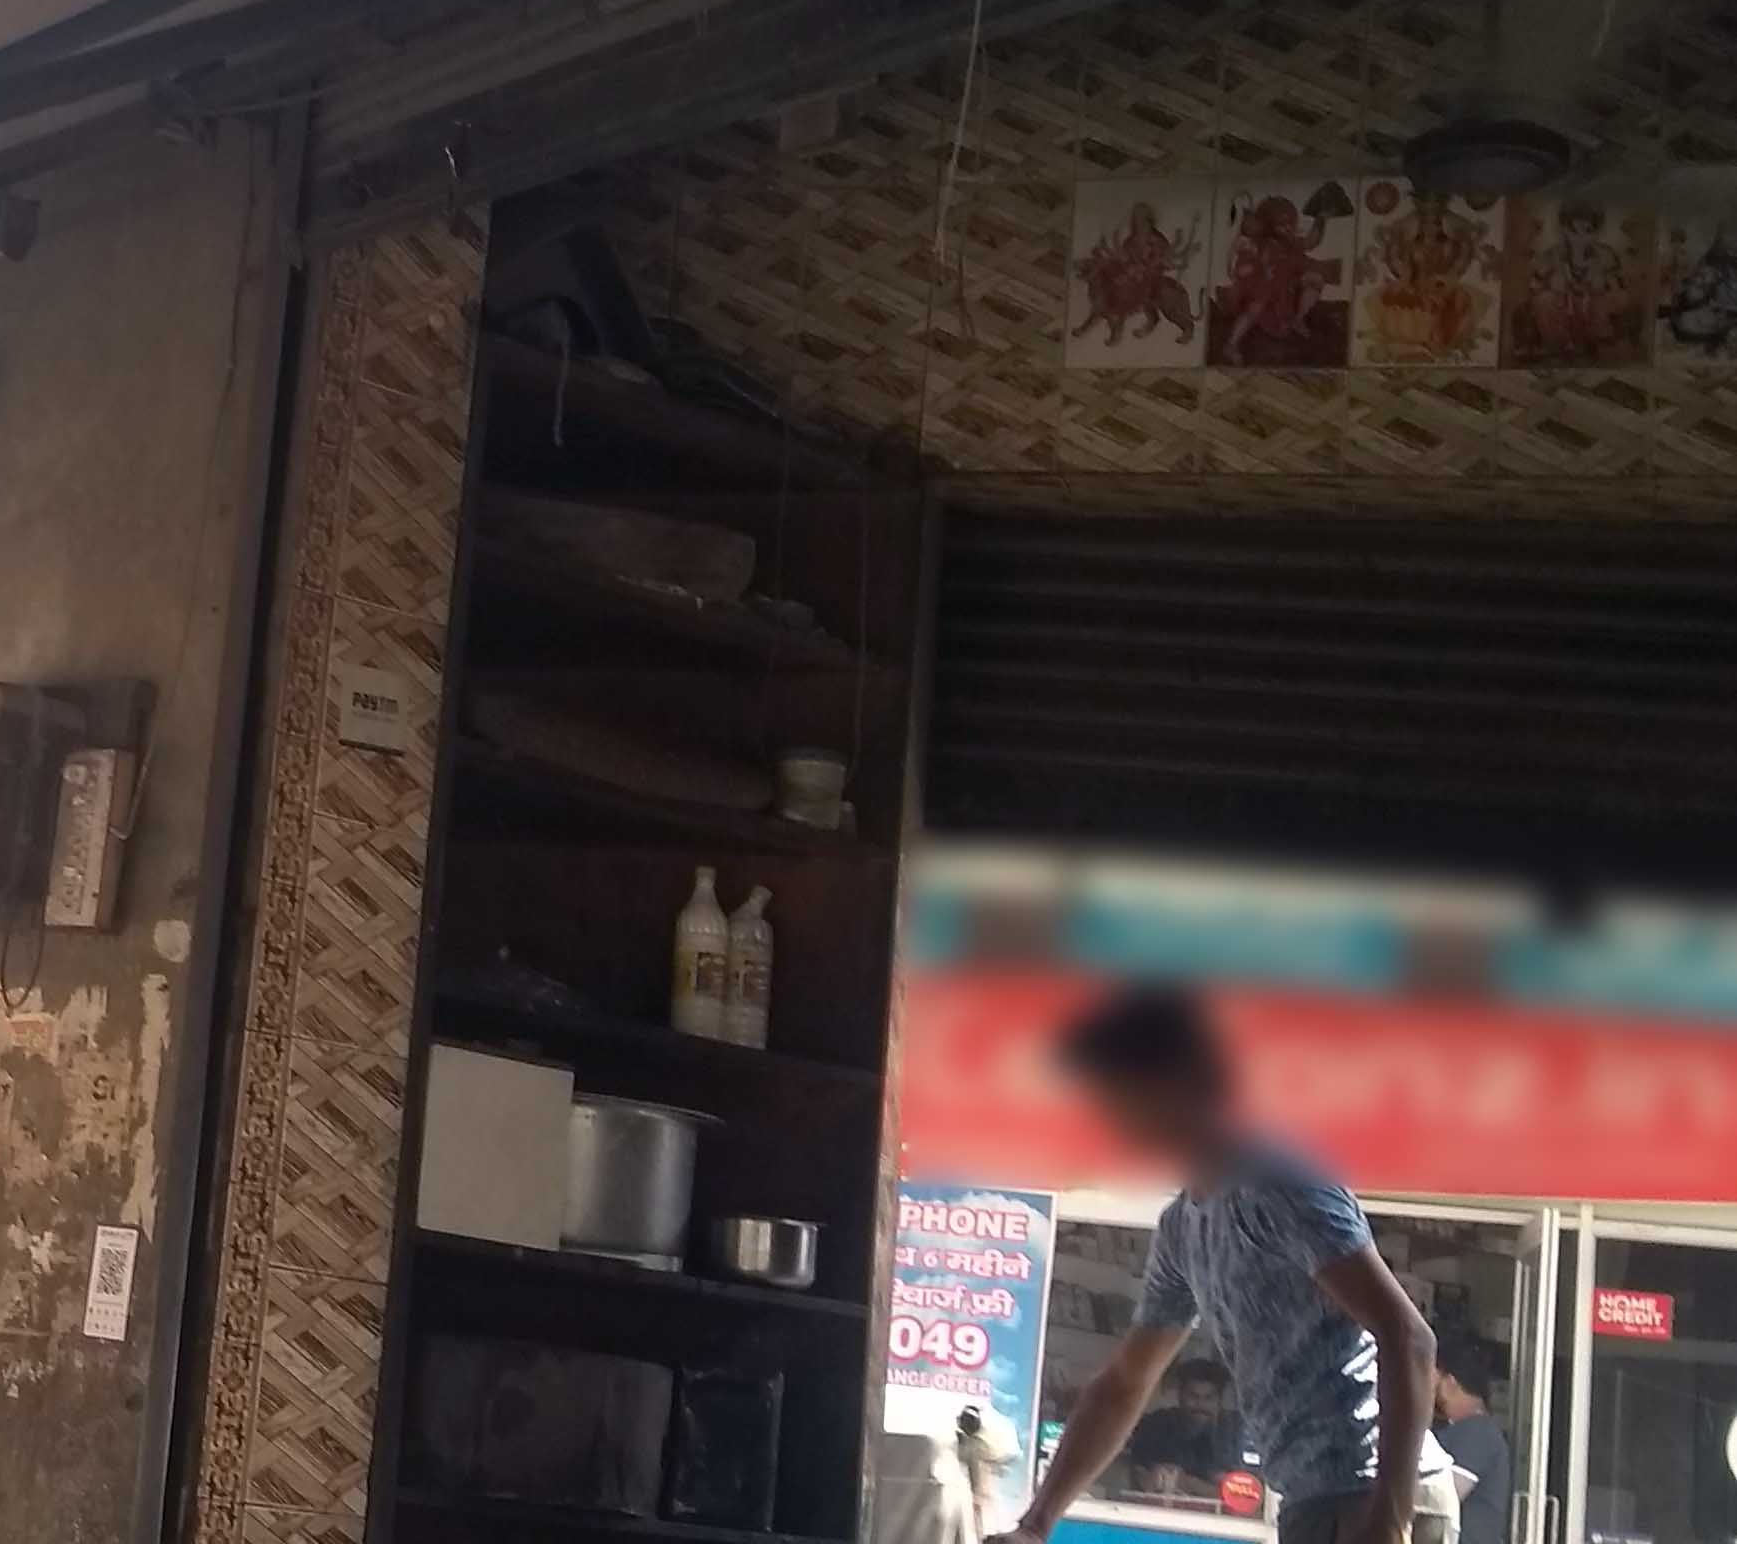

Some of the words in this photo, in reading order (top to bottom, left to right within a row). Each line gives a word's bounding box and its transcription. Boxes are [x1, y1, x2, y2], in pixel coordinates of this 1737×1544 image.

[899, 1201, 1030, 1242] PHONE
[1598, 1292, 1657, 1313] HOME
[1598, 1308, 1665, 1327] CREDIT
[934, 1373, 992, 1397] OFFER
